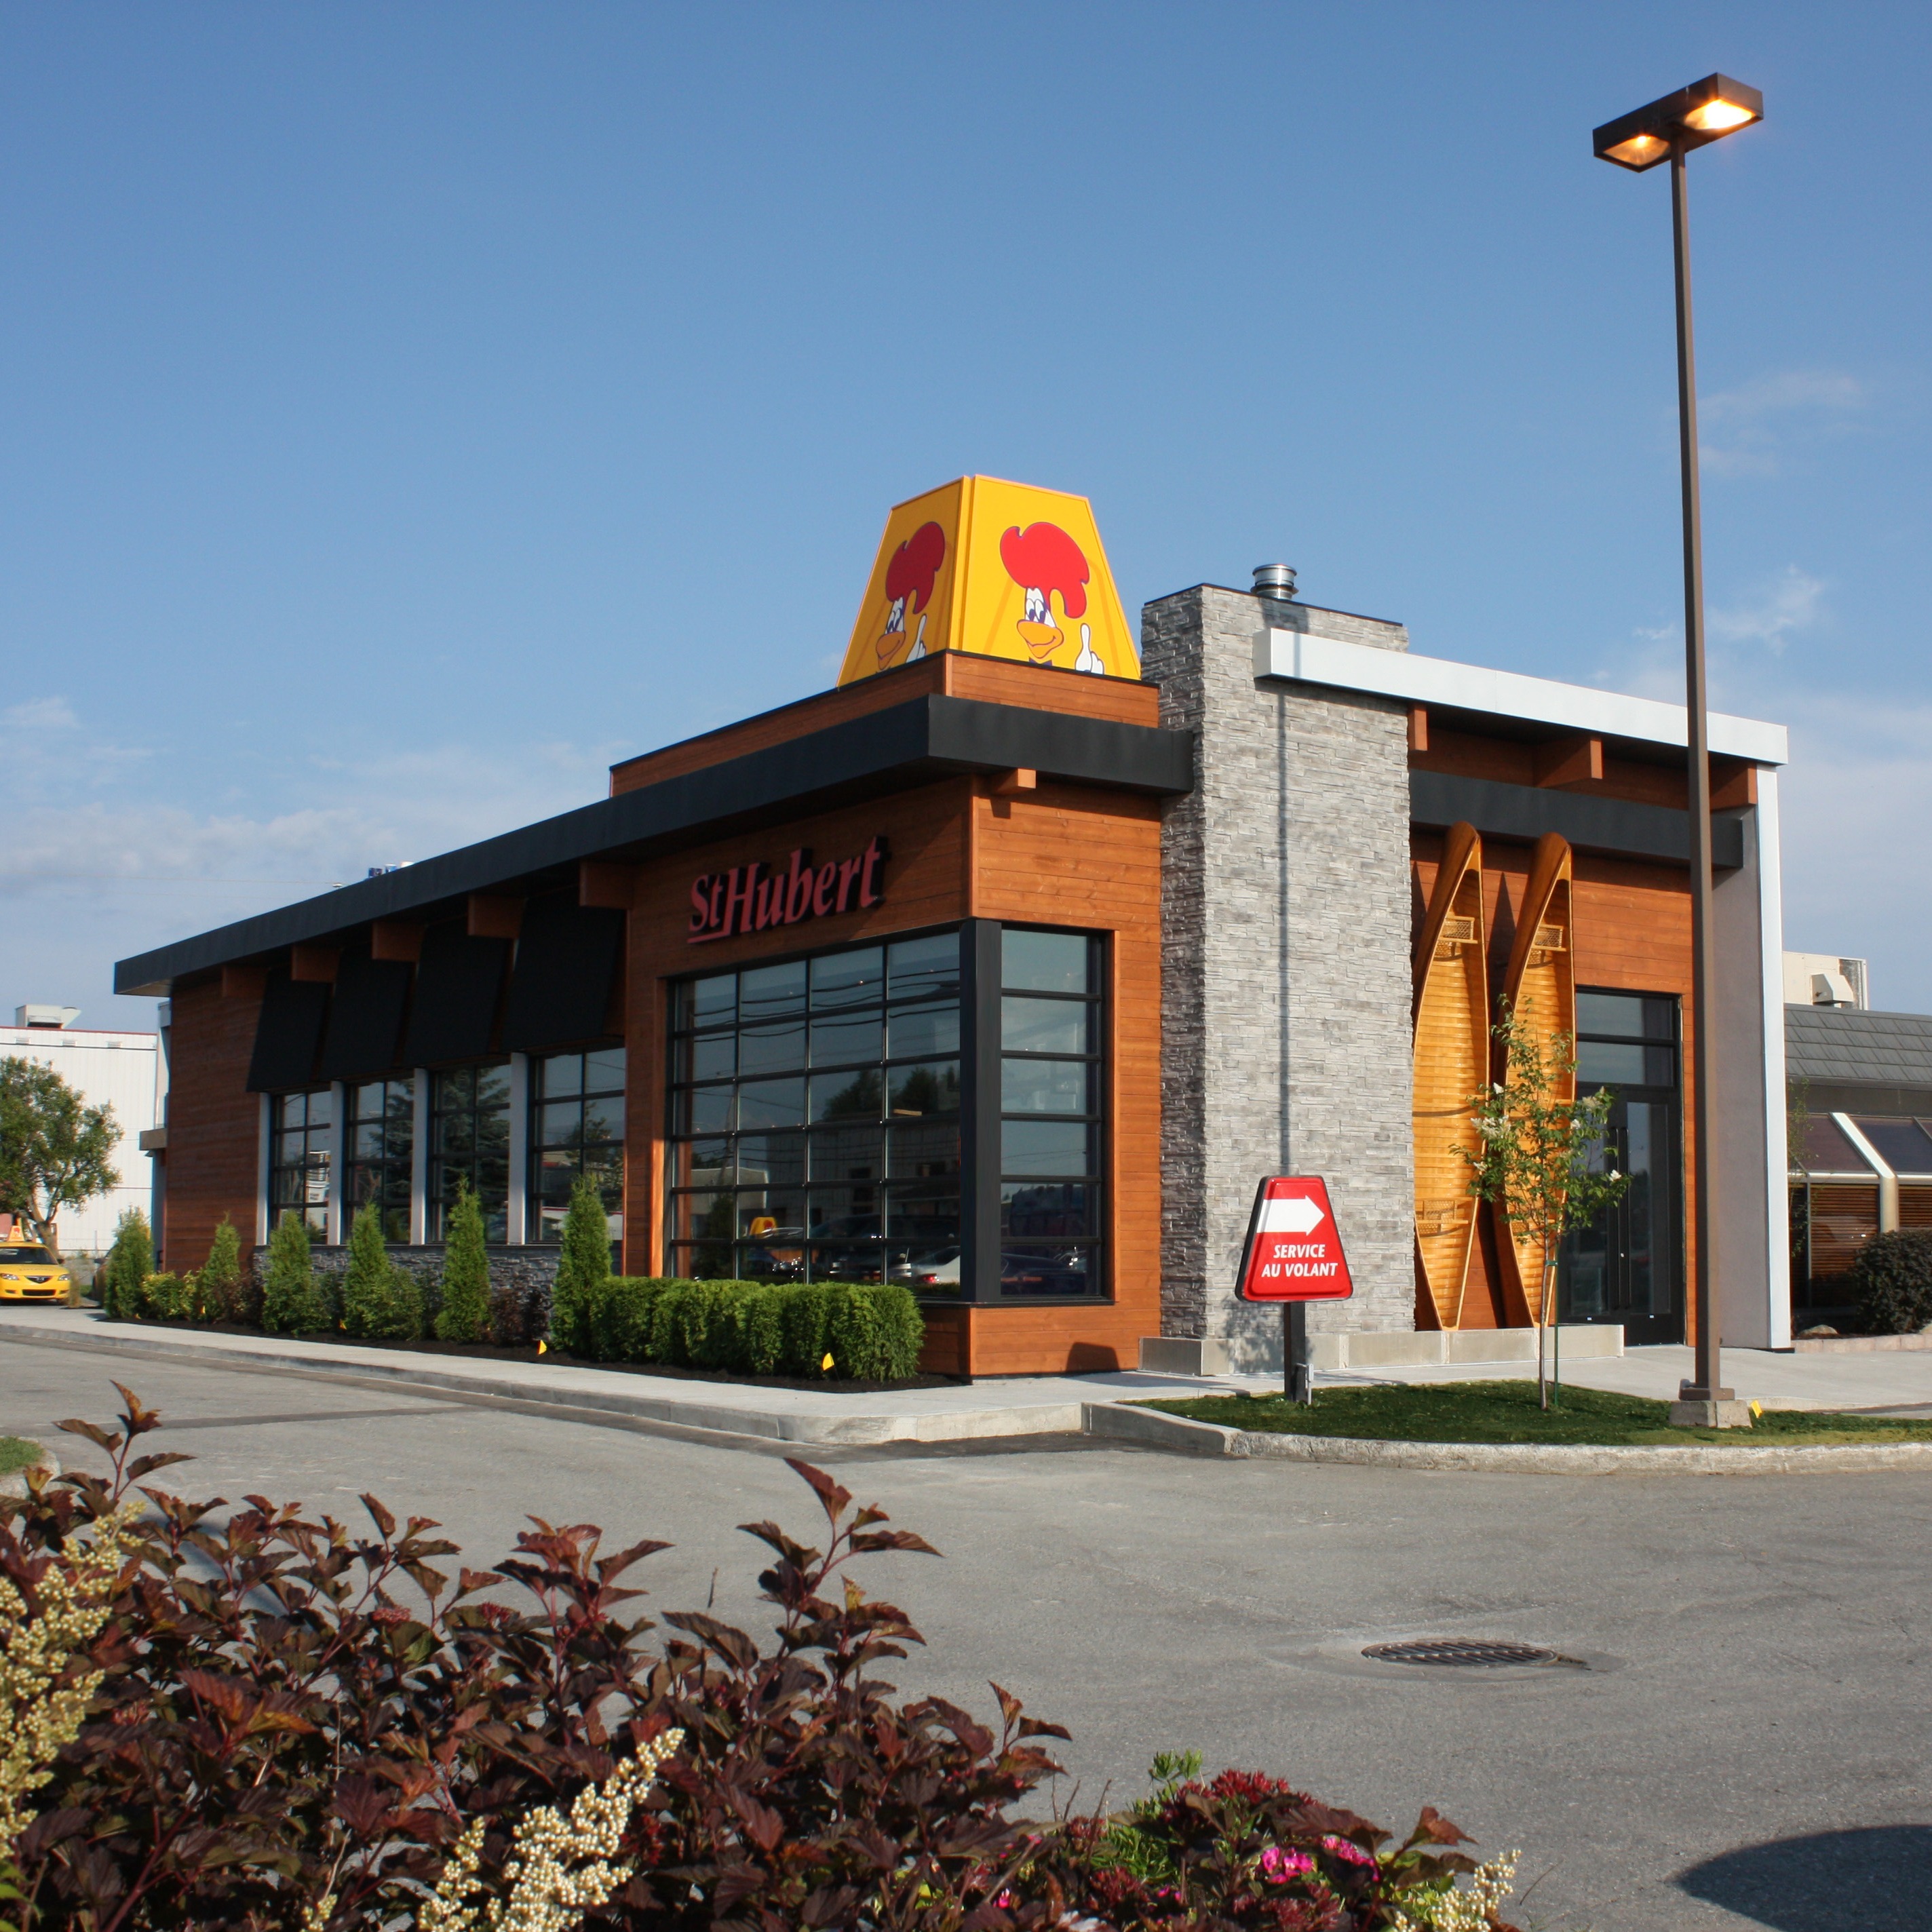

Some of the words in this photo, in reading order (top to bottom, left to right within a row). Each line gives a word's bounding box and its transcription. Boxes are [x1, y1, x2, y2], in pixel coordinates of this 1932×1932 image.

[1273, 1243, 1326, 1258] SERVICE
[1261, 1263, 1281, 1278] AU
[1284, 1262, 1338, 1277] VOLANT
